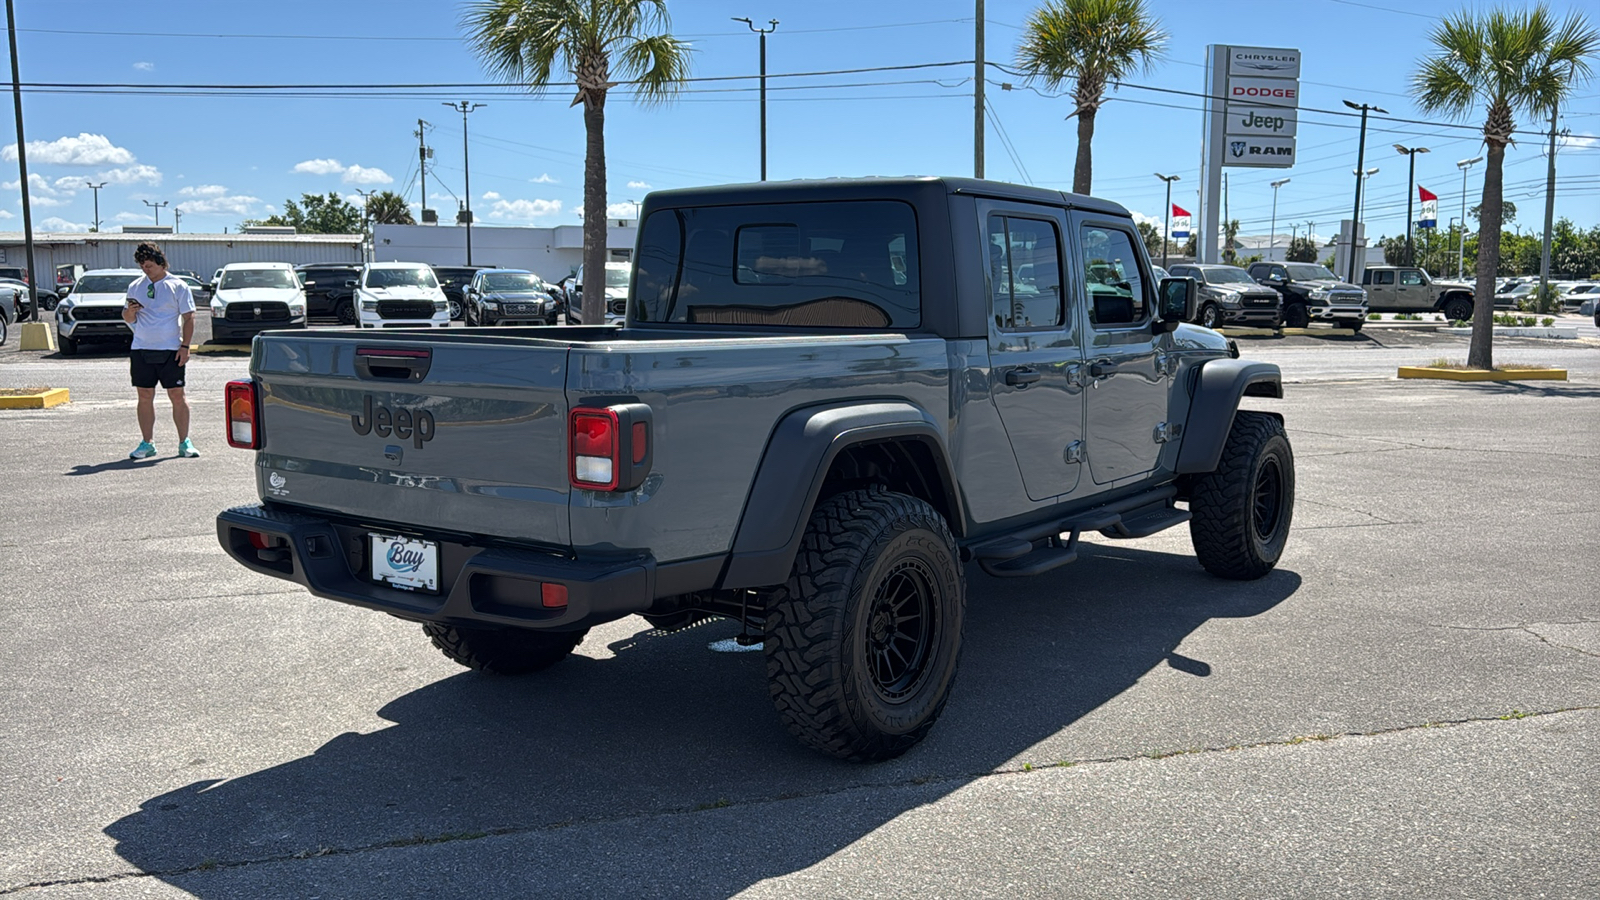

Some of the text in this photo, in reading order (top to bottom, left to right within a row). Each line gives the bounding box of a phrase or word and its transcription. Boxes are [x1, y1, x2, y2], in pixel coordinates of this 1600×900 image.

[1235, 53, 1296, 62] CHRYSLER
[1232, 86, 1296, 99] DODGE
[1241, 110, 1285, 132] Jeep
[1248, 145, 1292, 156] RAM
[351, 395, 436, 449] Jeep
[389, 541, 425, 573] Bay
